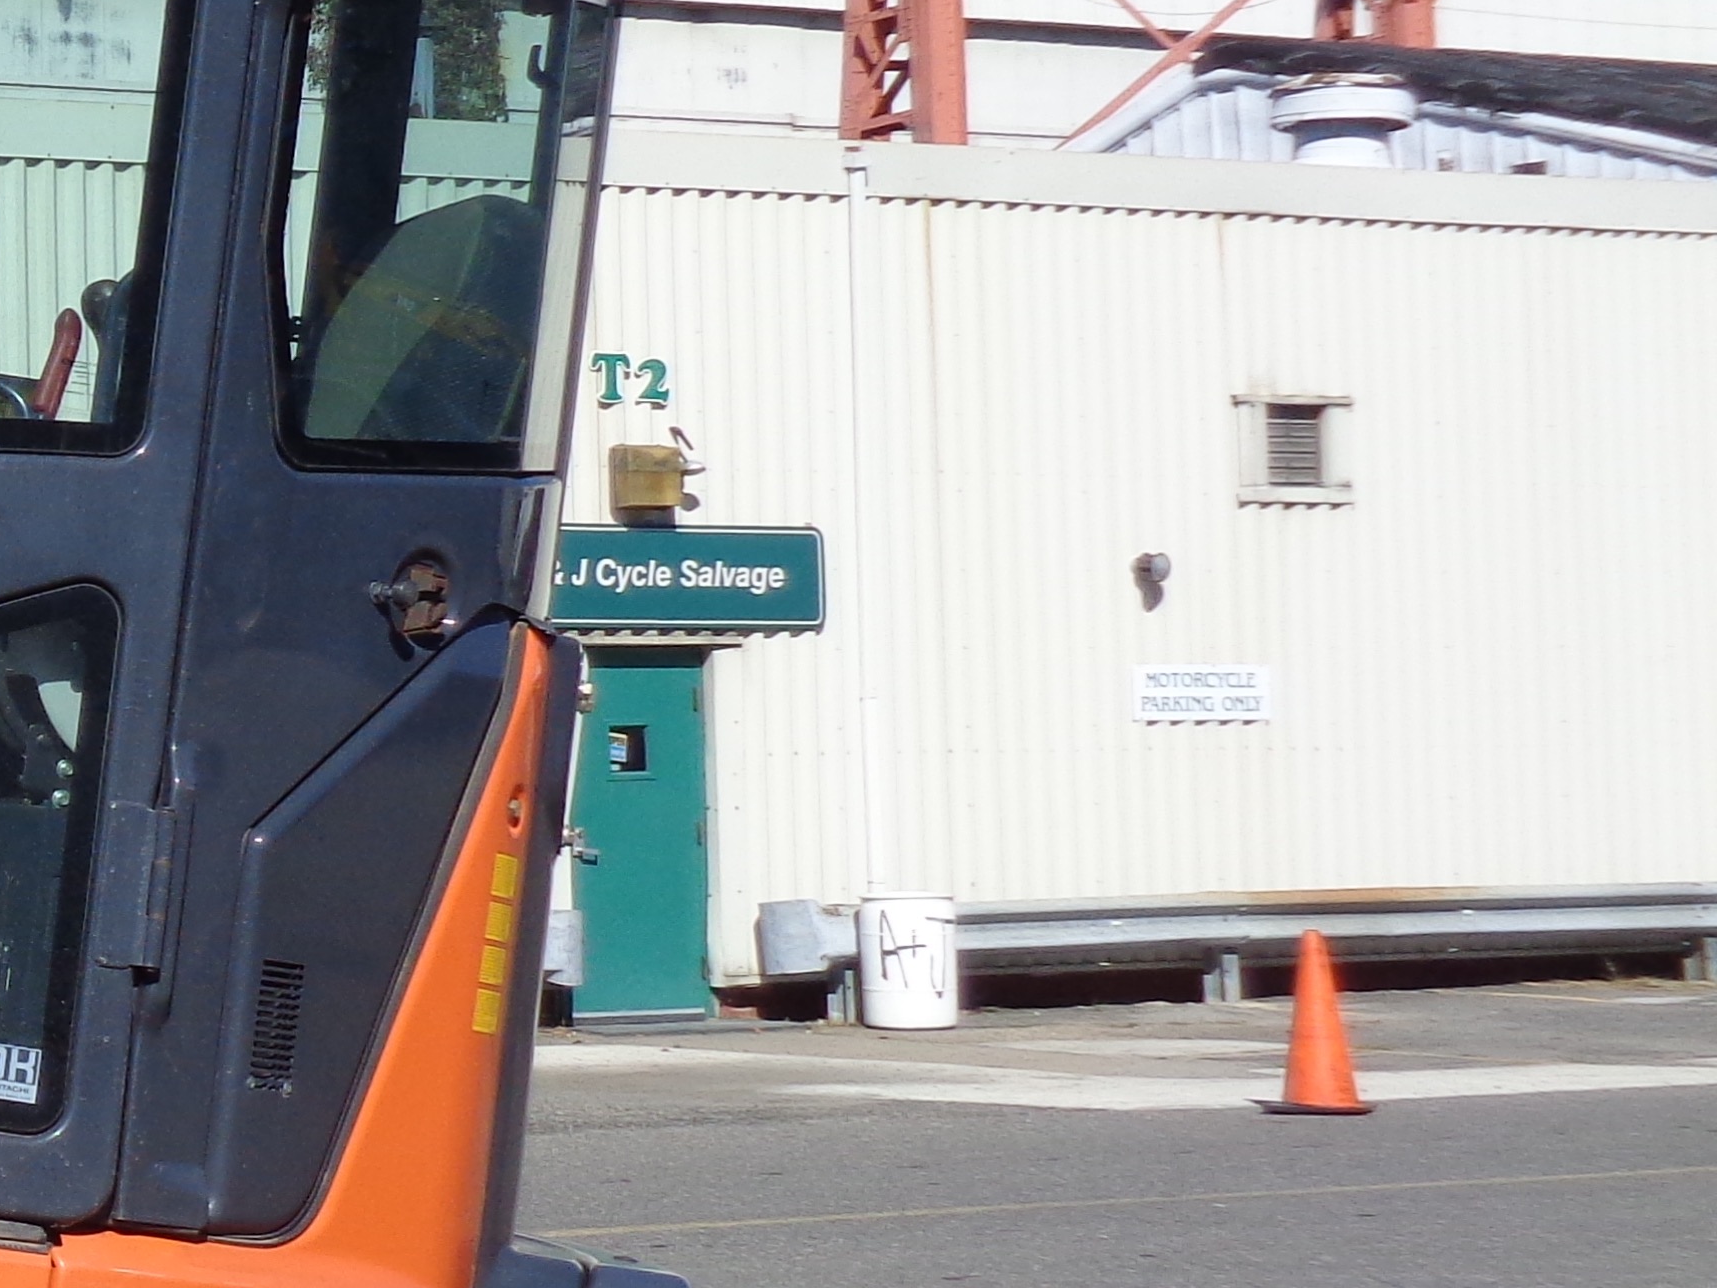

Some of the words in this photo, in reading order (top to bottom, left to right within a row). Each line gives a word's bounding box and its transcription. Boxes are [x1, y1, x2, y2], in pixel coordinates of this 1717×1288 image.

[571, 558, 589, 586] J
[595, 558, 672, 593] Cycle
[680, 560, 785, 595] Salvage
[1145, 672, 1256, 688] MOTORCYCLE
[1141, 696, 1215, 712] PARKING
[1222, 696, 1263, 712] ONLY
